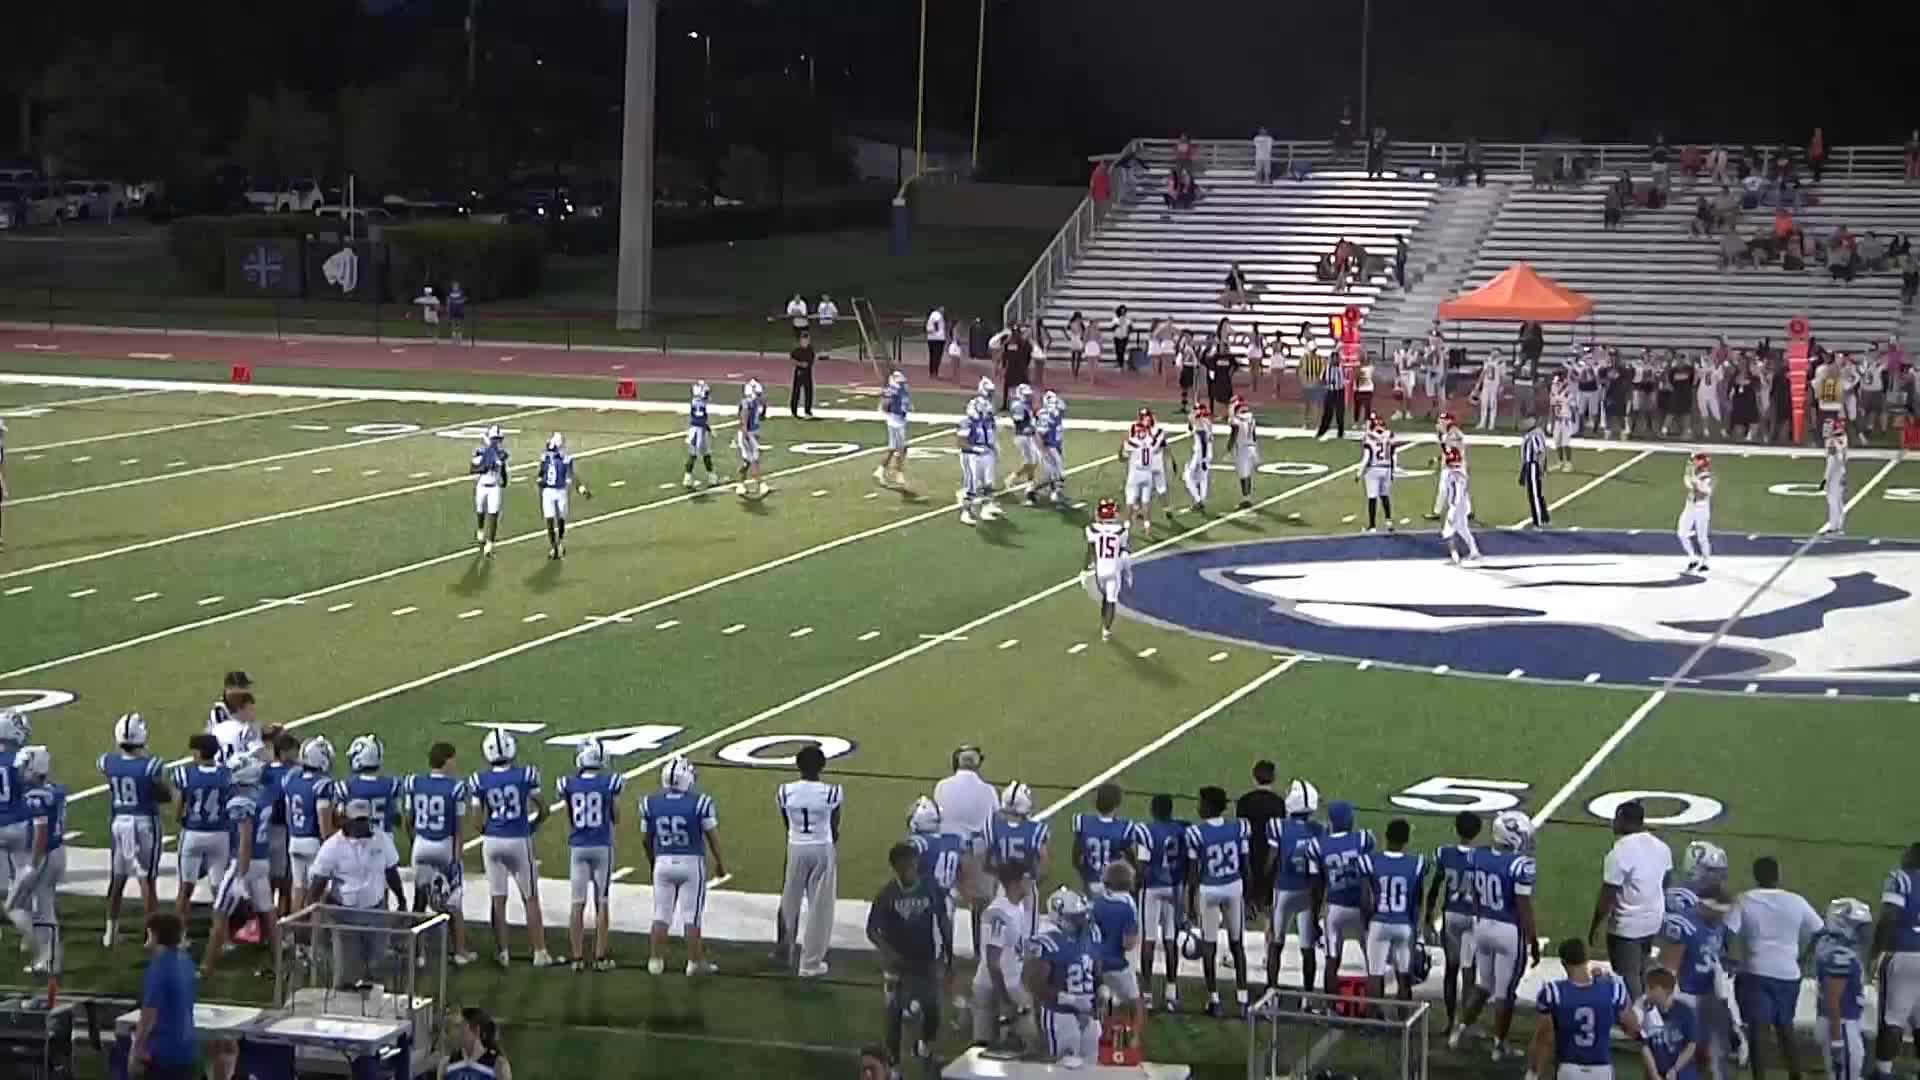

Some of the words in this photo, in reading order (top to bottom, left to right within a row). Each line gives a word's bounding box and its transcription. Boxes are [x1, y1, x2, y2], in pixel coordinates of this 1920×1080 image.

[1098, 535, 1117, 559] 15
[192, 787, 221, 823] 14
[414, 795, 444, 831] 89
[486, 784, 521, 820] 93
[574, 792, 602, 828] 88
[799, 807, 811, 834] 1
[1206, 840, 1239, 878] 23
[1377, 875, 1408, 913] 10
[1475, 869, 1504, 912] 90
[1573, 1006, 1596, 1048] 3
